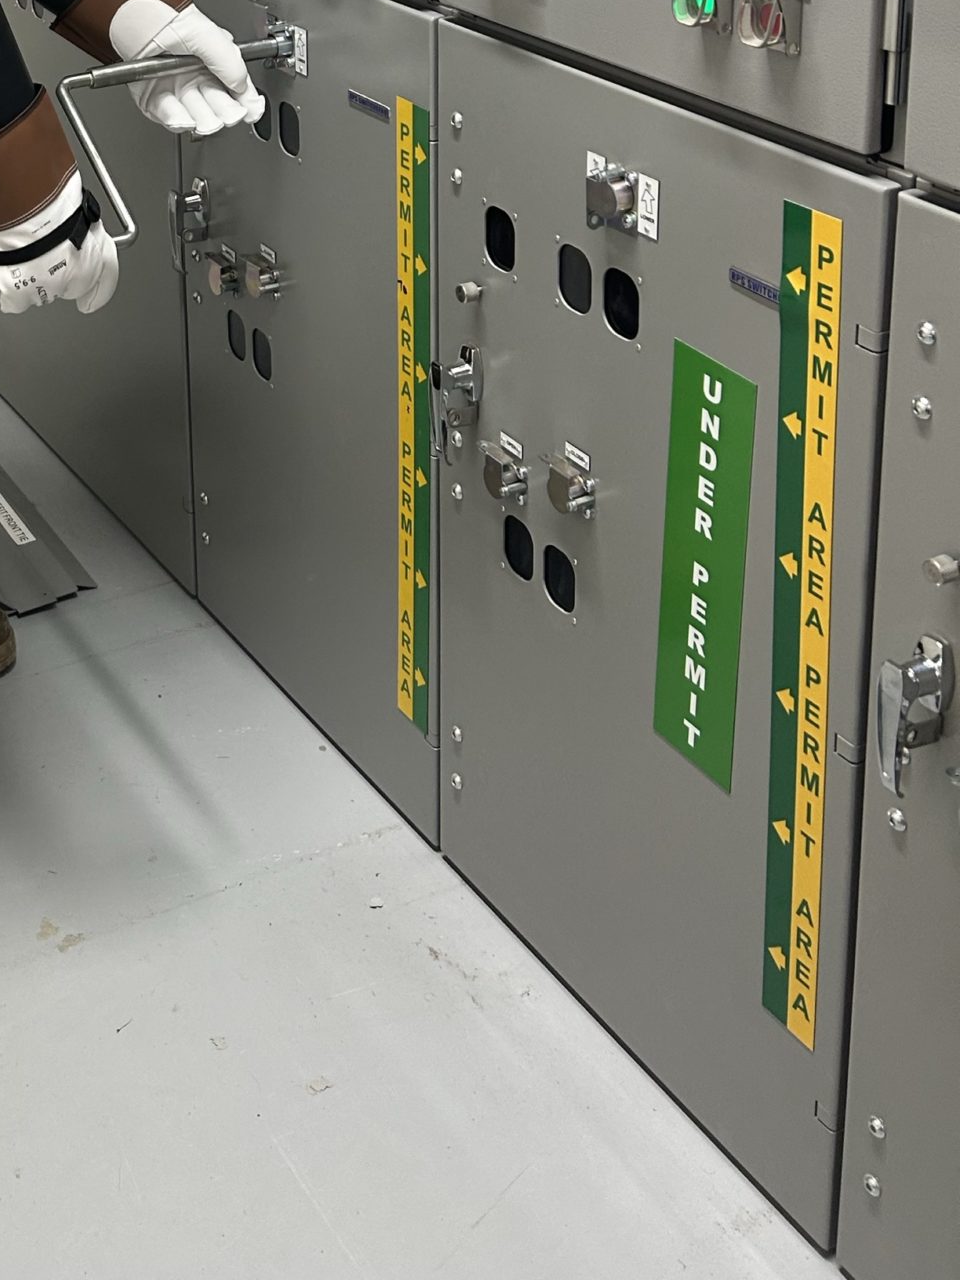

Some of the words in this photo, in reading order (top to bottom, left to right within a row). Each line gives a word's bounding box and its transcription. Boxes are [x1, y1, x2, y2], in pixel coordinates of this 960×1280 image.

[400, 122, 412, 273] PERMIT
[400, 306, 412, 403] AREA
[811, 244, 835, 458] PERMIT
[401, 441, 412, 580] PERMIT
[694, 373, 722, 541] UNDER
[804, 501, 827, 637] AREA
[401, 610, 412, 699] AREA
[683, 561, 710, 749] PERMIT
[800, 664, 821, 859] PERMIT
[792, 897, 814, 1022] AREA
